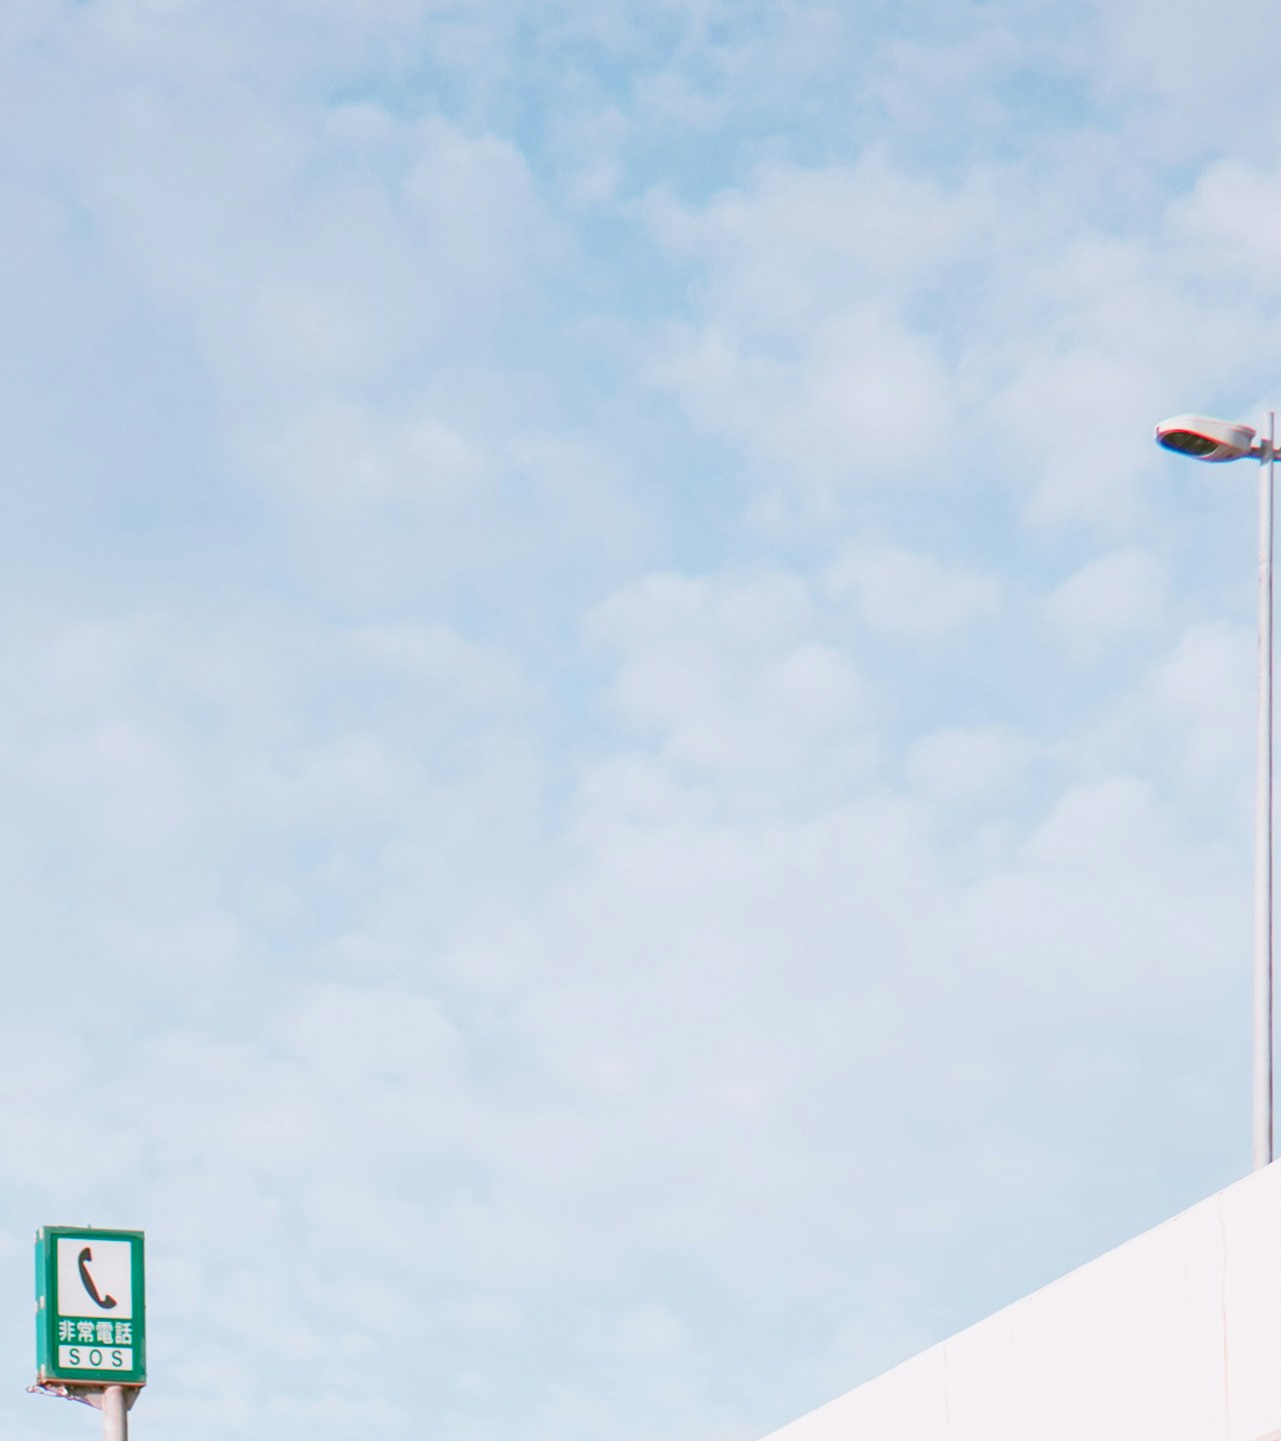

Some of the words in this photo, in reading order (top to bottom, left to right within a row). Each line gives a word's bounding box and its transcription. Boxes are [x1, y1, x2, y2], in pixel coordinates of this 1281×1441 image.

[58, 1319, 133, 1345] 非常電話
[68, 1347, 124, 1368] SOS
